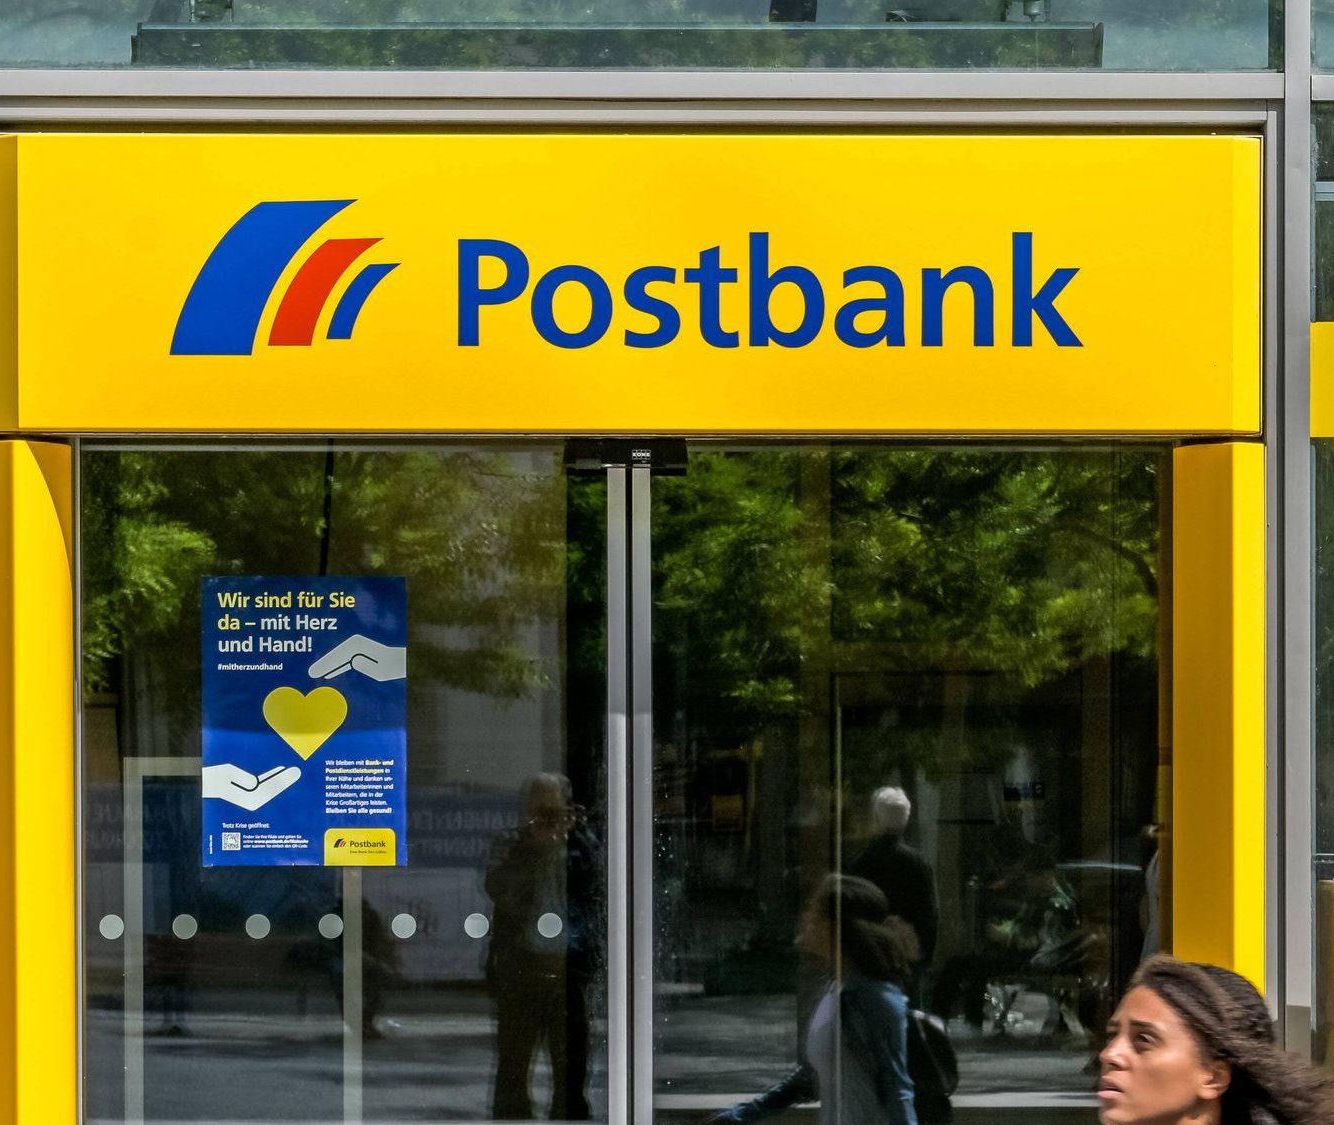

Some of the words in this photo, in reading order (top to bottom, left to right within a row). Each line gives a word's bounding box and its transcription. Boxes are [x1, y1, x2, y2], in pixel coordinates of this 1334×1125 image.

[458, 232, 1084, 349] Postbank
[217, 592, 250, 608] Wir
[255, 591, 292, 608] sind
[297, 591, 324, 608] für
[329, 592, 355, 608] Sie
[217, 614, 240, 630] da
[260, 614, 290, 630] mit
[296, 615, 337, 630] Herz
[218, 636, 253, 652] und
[259, 636, 312, 652] Hand!
[217, 663, 283, 671] #mitherzundhand
[350, 840, 386, 848] Postbank
